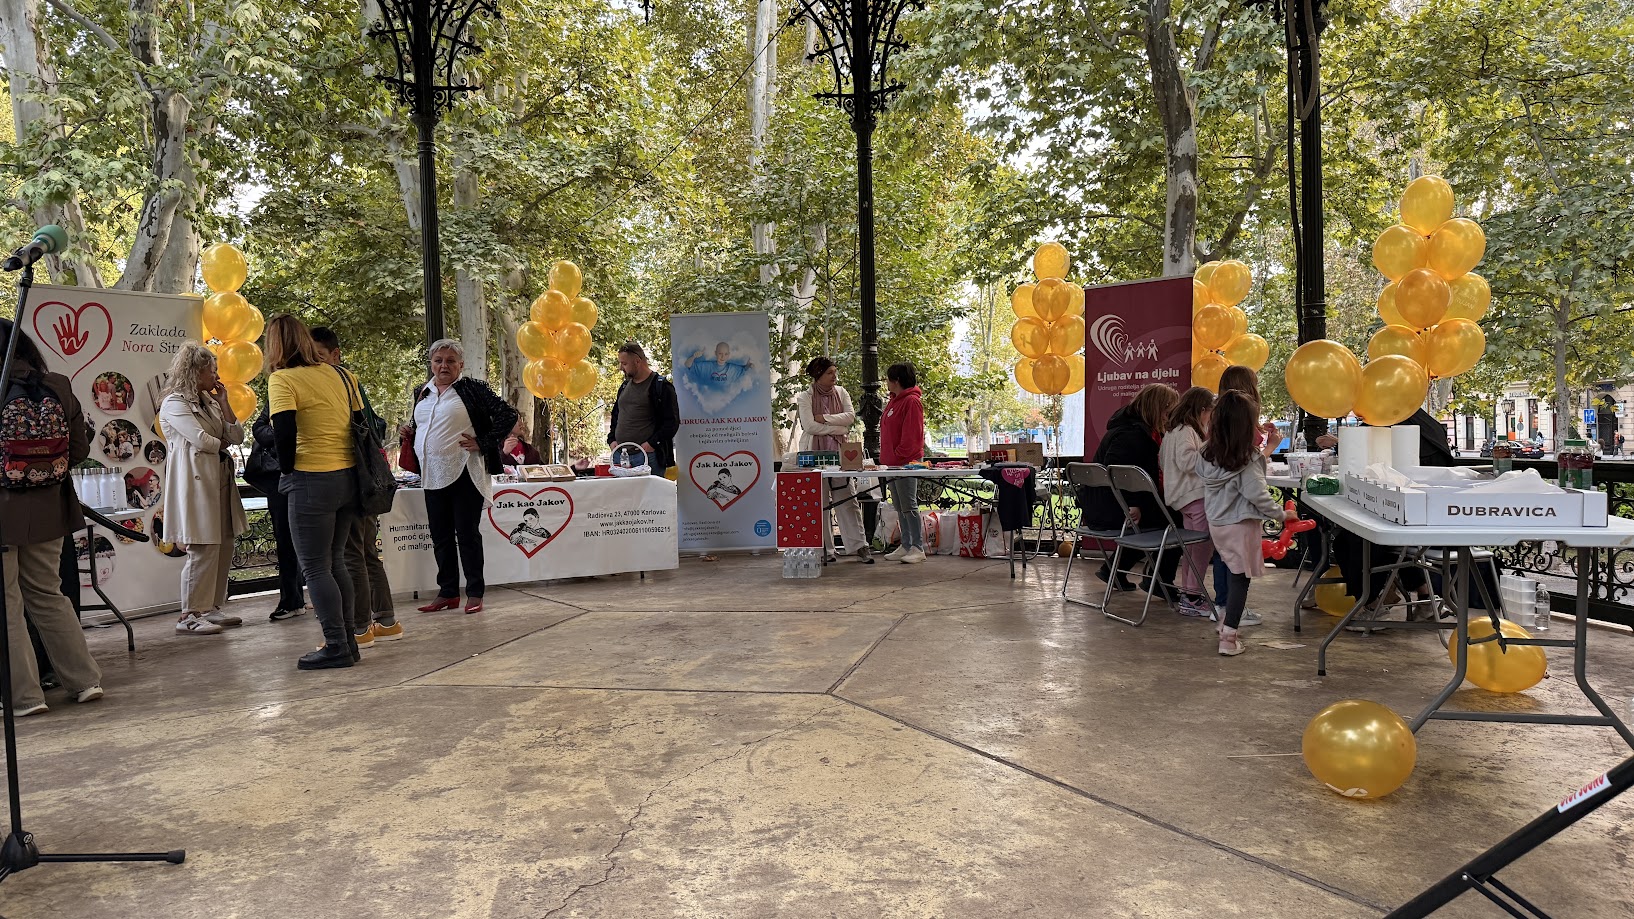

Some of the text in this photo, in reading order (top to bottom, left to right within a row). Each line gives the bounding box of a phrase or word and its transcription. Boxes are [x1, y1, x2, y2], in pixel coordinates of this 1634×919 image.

[129, 323, 187, 338] Zaklada
[121, 340, 155, 353] Nora
[1097, 368, 1180, 383] Ljubav na djelu
[1117, 383, 1140, 391] roditelja
[496, 501, 515, 509] Jak
[1447, 505, 1557, 517] DUBRAVICA
[599, 519, 654, 527] www.jakkaojakov.hr
[393, 533, 417, 543] pomoć
[583, 530, 601, 538] IBAN:
